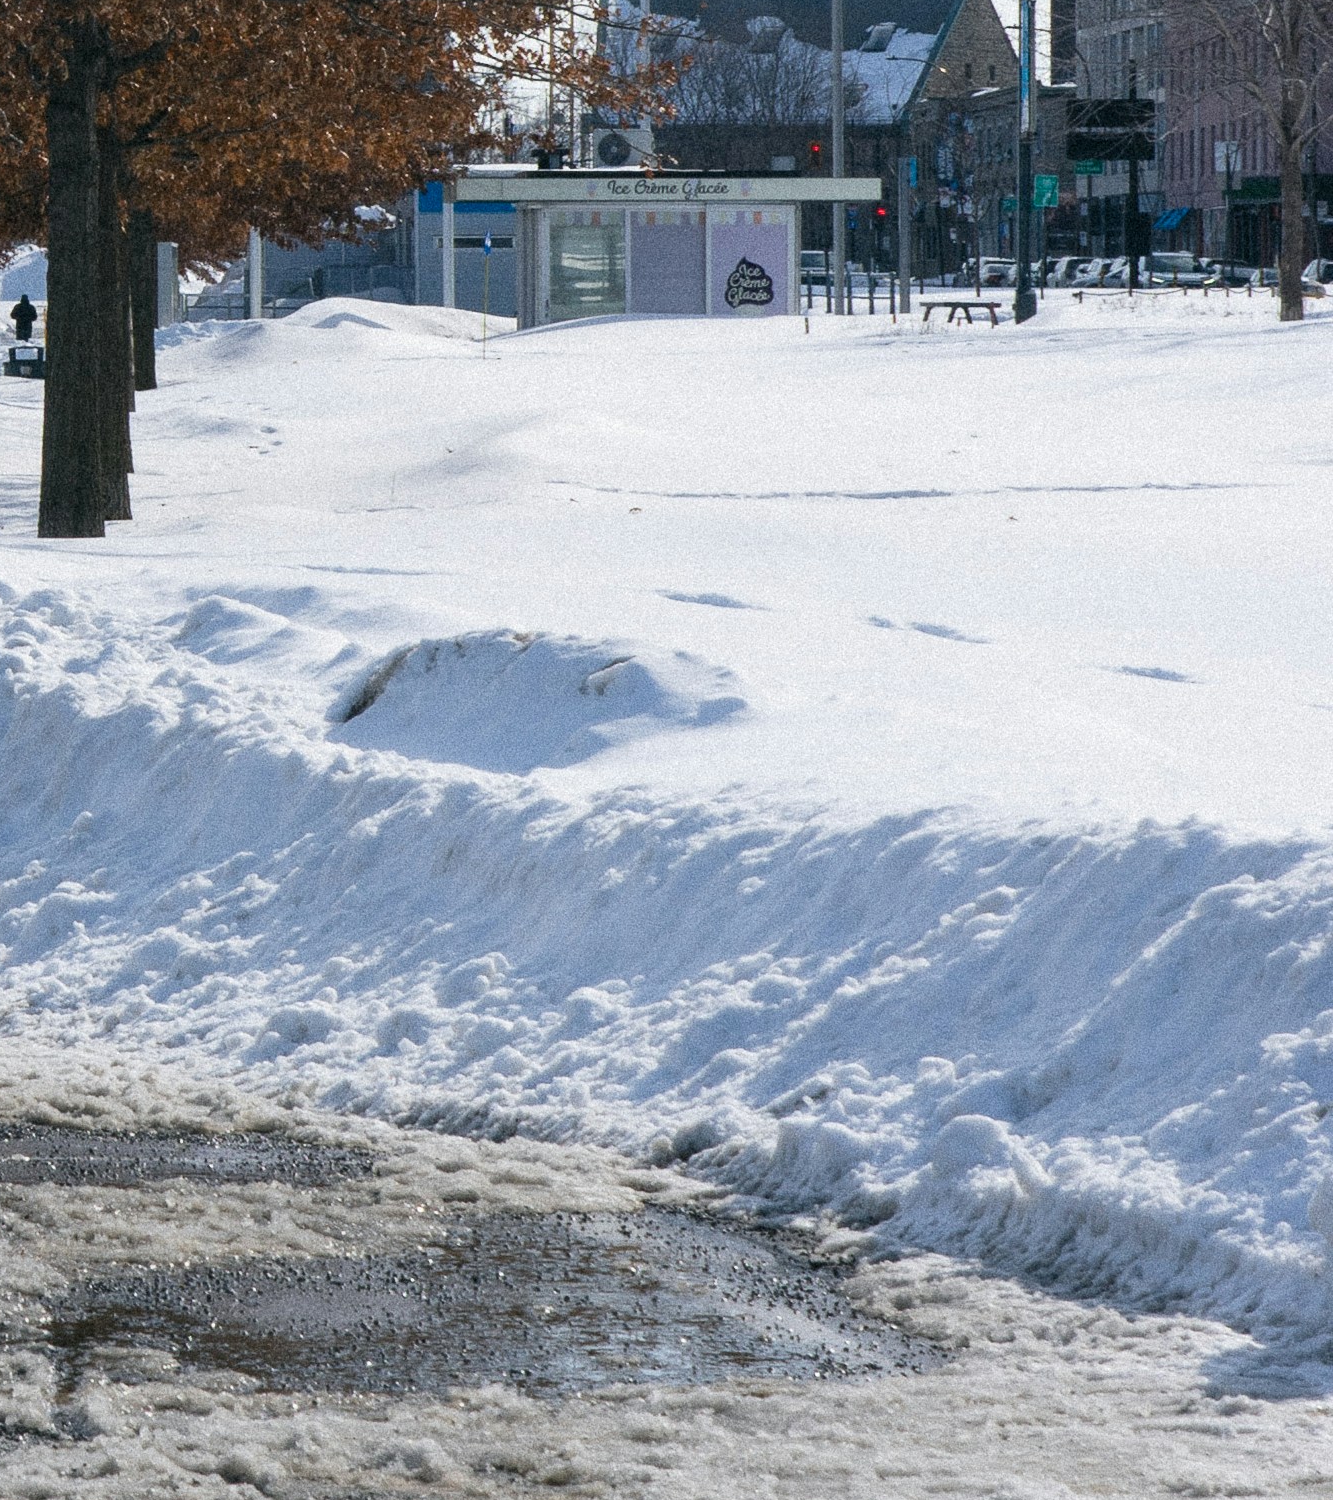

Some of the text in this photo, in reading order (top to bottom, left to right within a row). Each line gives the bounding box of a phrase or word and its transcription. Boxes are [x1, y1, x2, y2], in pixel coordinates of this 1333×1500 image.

[607, 180, 631, 195] Ice
[634, 180, 678, 195] Crème
[738, 264, 762, 277] Ice
[729, 273, 771, 288] Crème
[727, 287, 771, 305] Glacée
